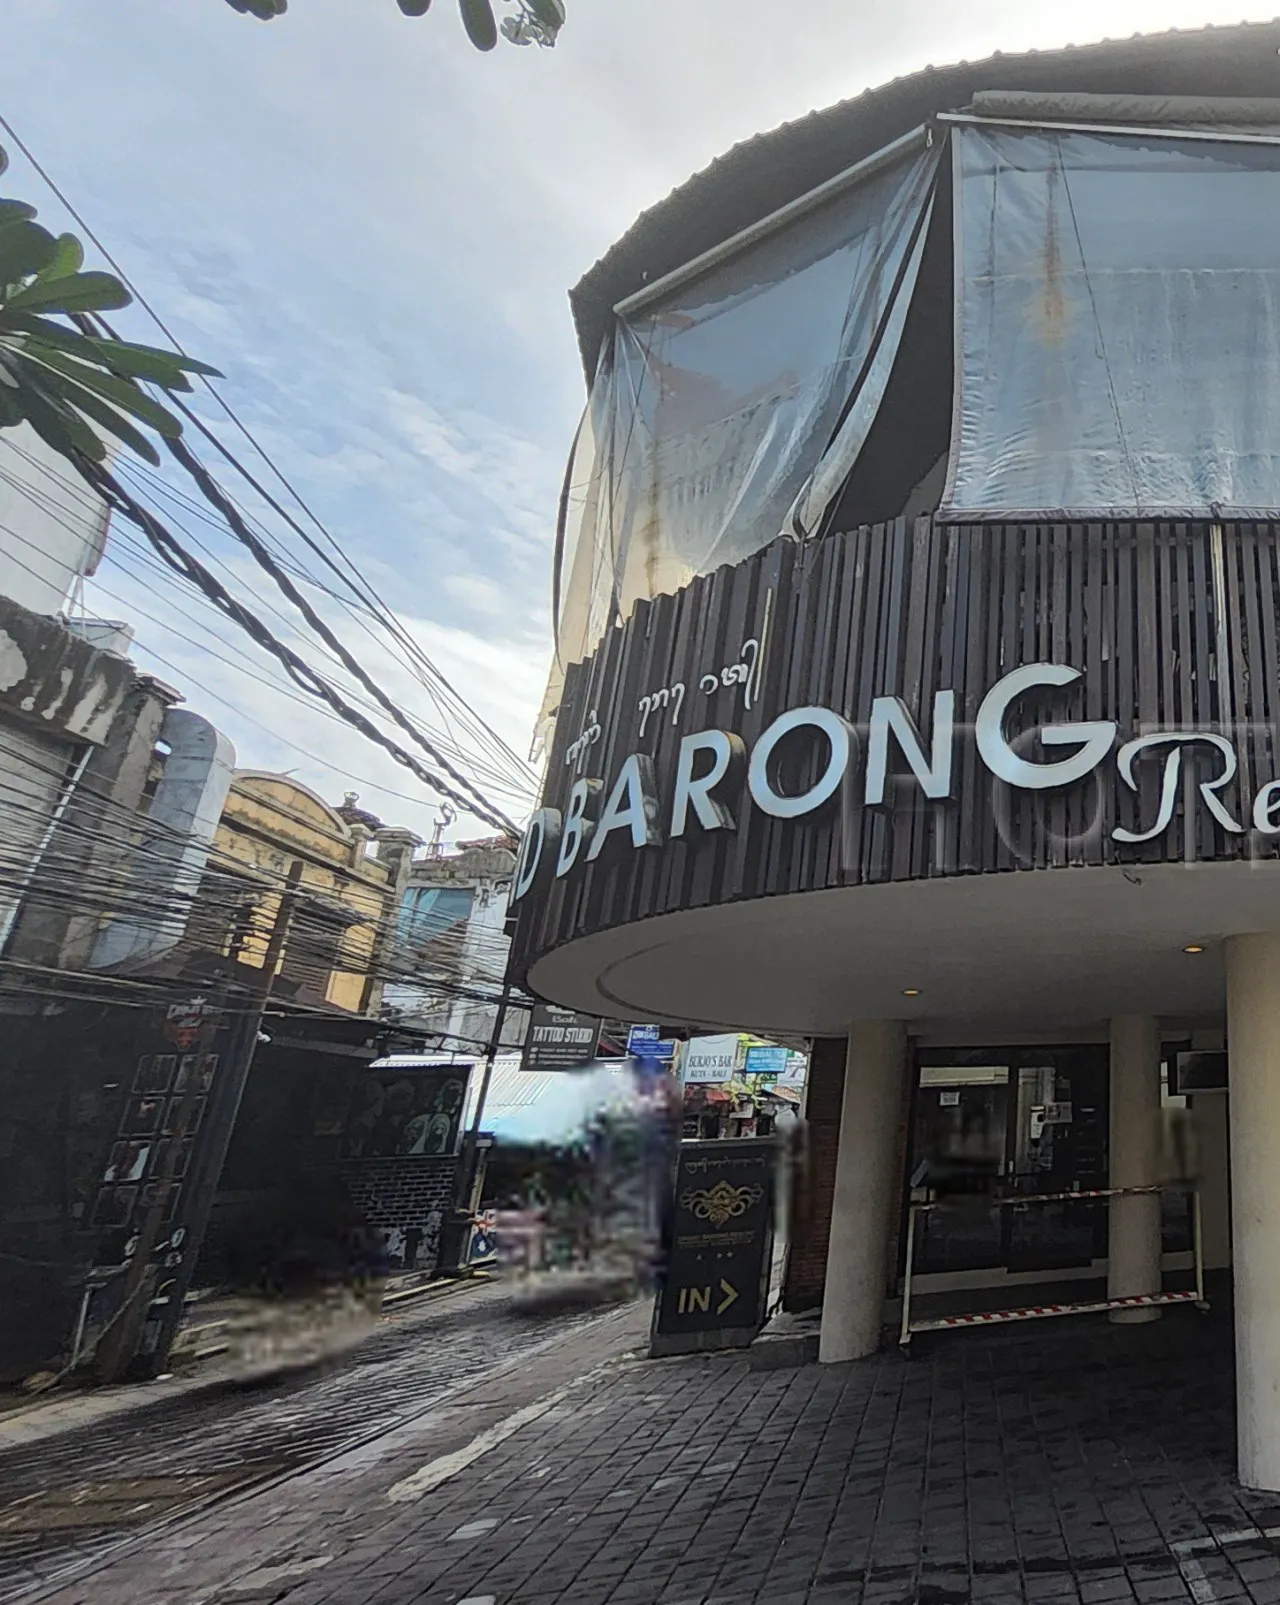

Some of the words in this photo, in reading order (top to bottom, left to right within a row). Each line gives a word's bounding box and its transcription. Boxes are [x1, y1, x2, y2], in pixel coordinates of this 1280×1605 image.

[556, 663, 1117, 878] BARONG
[532, 1026, 564, 1043] TATTOO
[678, 1286, 711, 1314] IN
